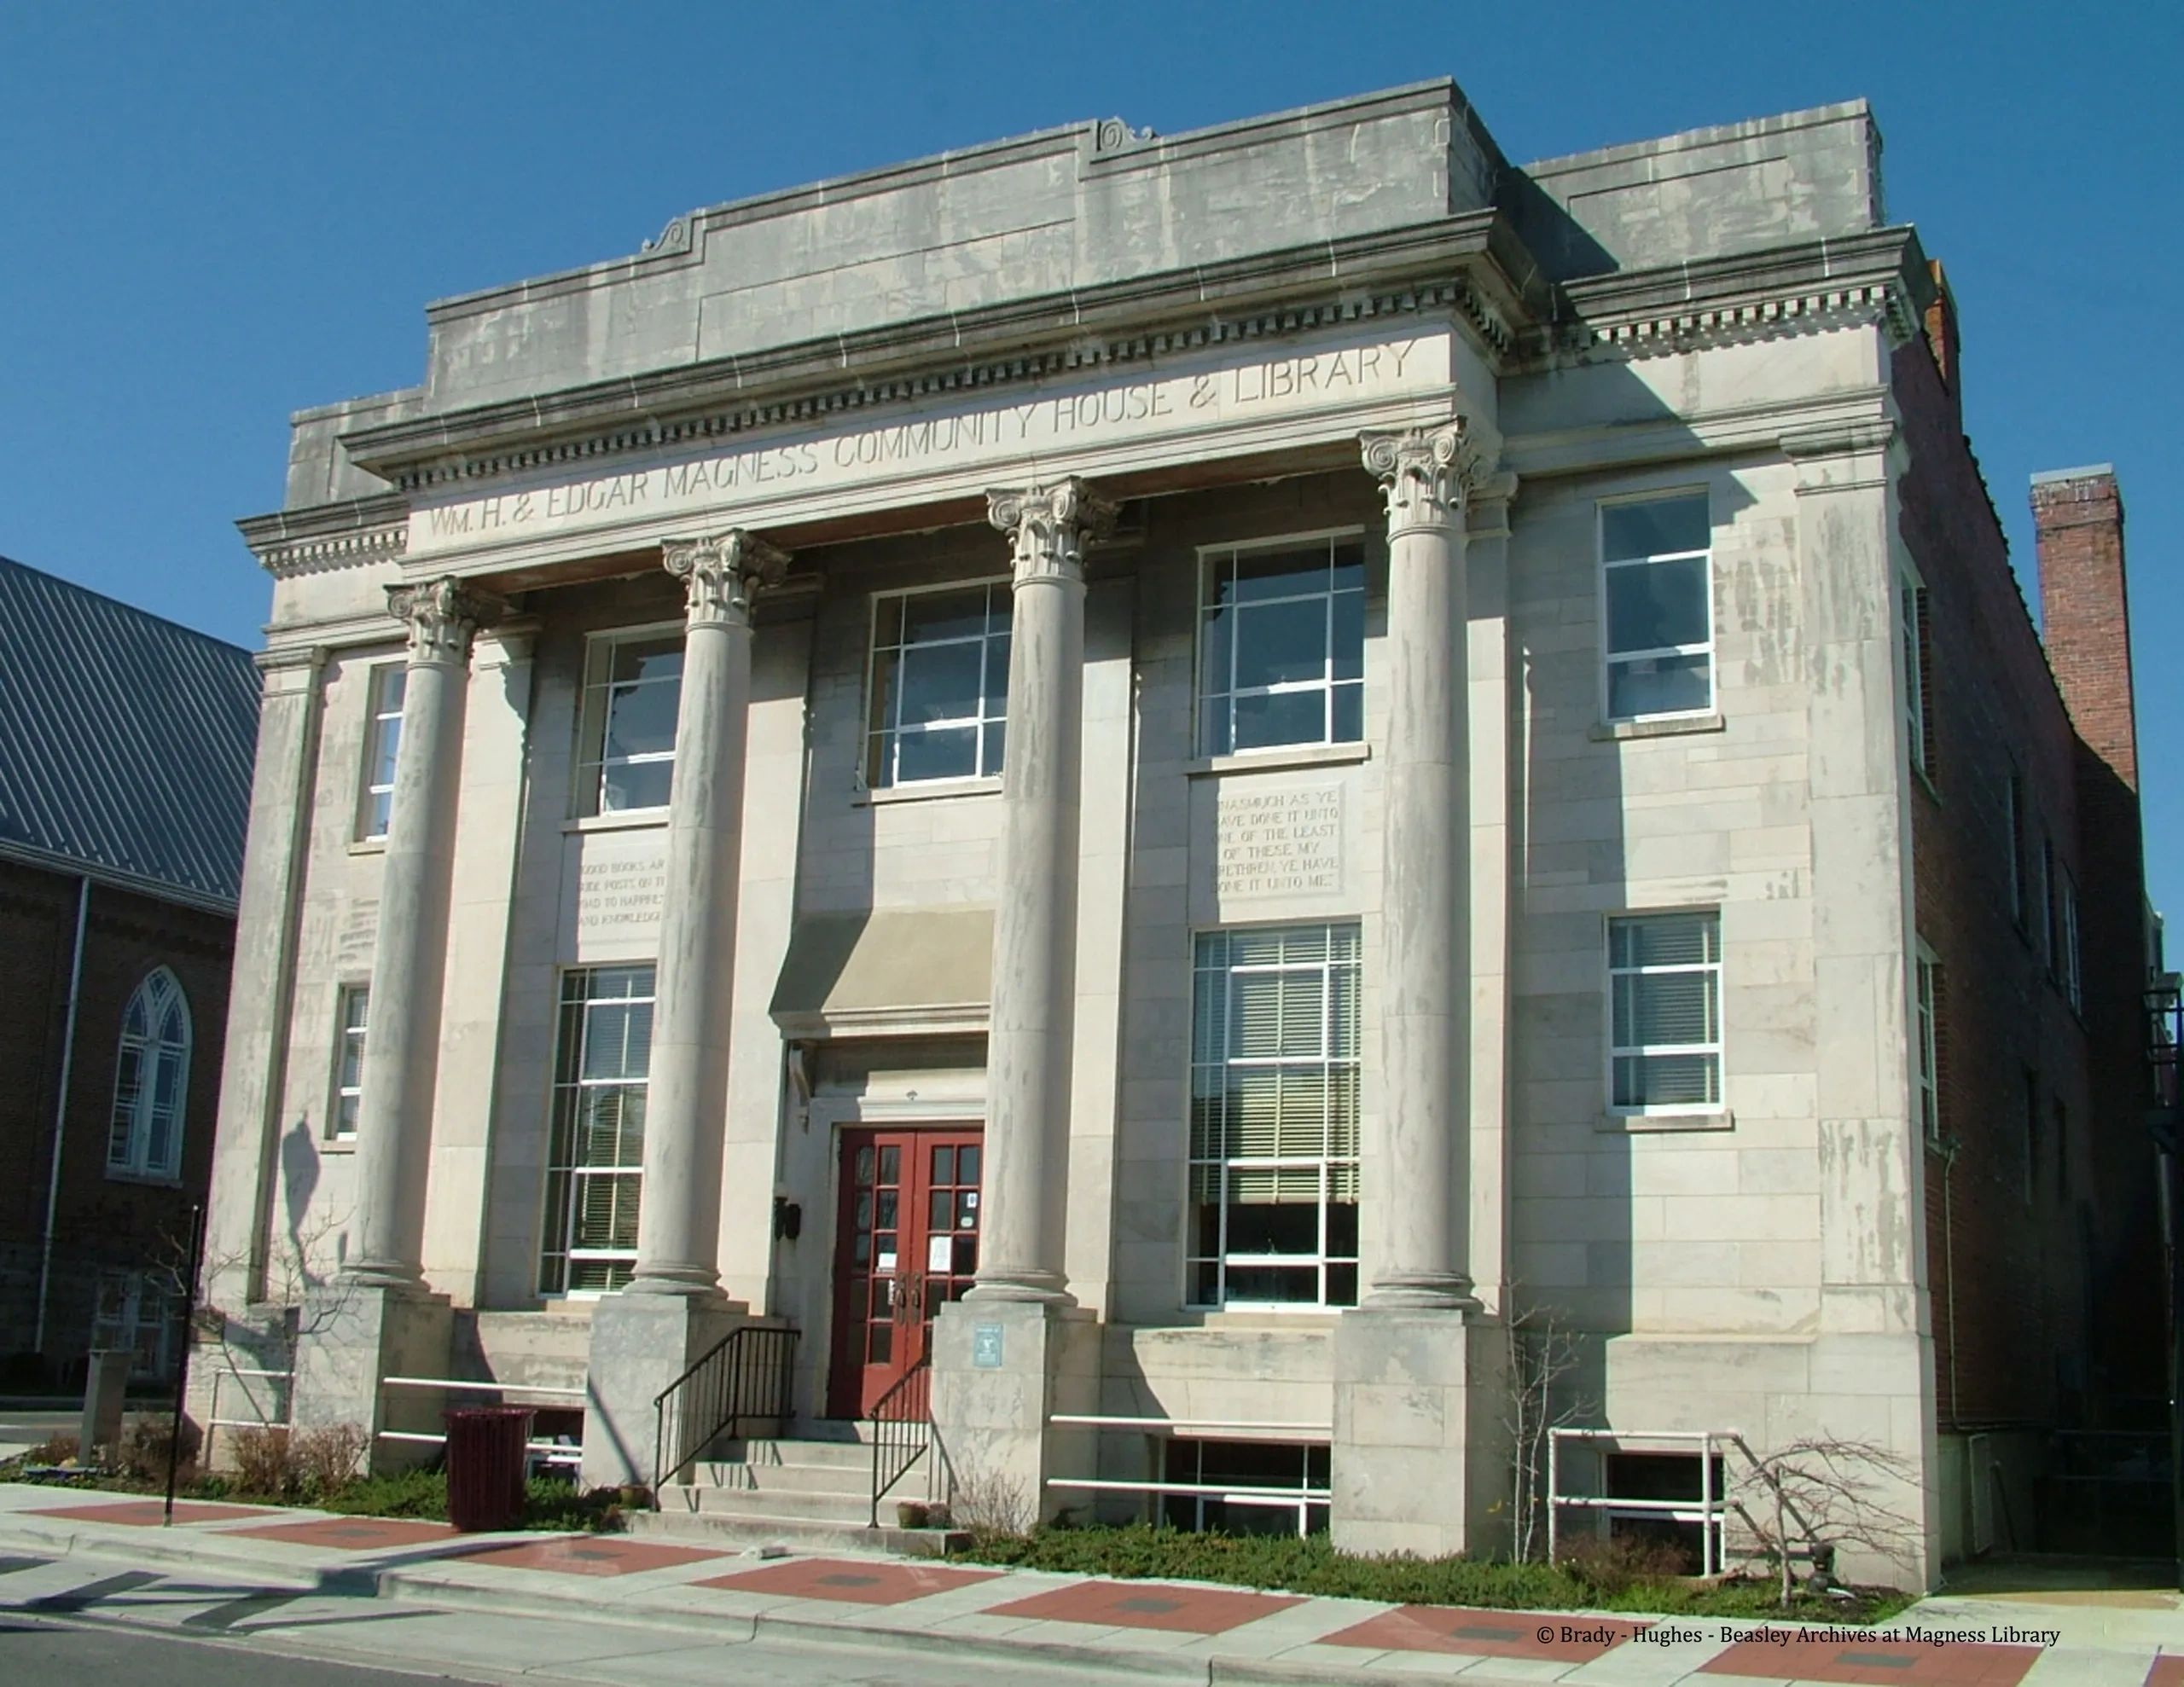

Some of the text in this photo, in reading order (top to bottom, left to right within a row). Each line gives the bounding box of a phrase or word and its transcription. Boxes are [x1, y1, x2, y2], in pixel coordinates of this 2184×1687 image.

[513, 493, 535, 522] &
[546, 473, 647, 519] EDGAR
[664, 443, 819, 498] MAGNESS
[834, 403, 1038, 467] COMMUNITY
[1054, 383, 1173, 432] HOUSE
[1189, 375, 1217, 409] &
[1235, 340, 1416, 403] LIBRARY
[1290, 794, 1310, 807] AS
[1316, 791, 1338, 803] YE
[1215, 814, 1246, 827] AVE
[1240, 830, 1257, 843] OF
[1264, 828, 1288, 842] THE
[1293, 825, 1336, 839] LEAST
[1247, 844, 1292, 858] THESE
[1298, 841, 1321, 855] MY
[650, 859, 665, 870] AR
[1303, 856, 1339, 871] HAVE
